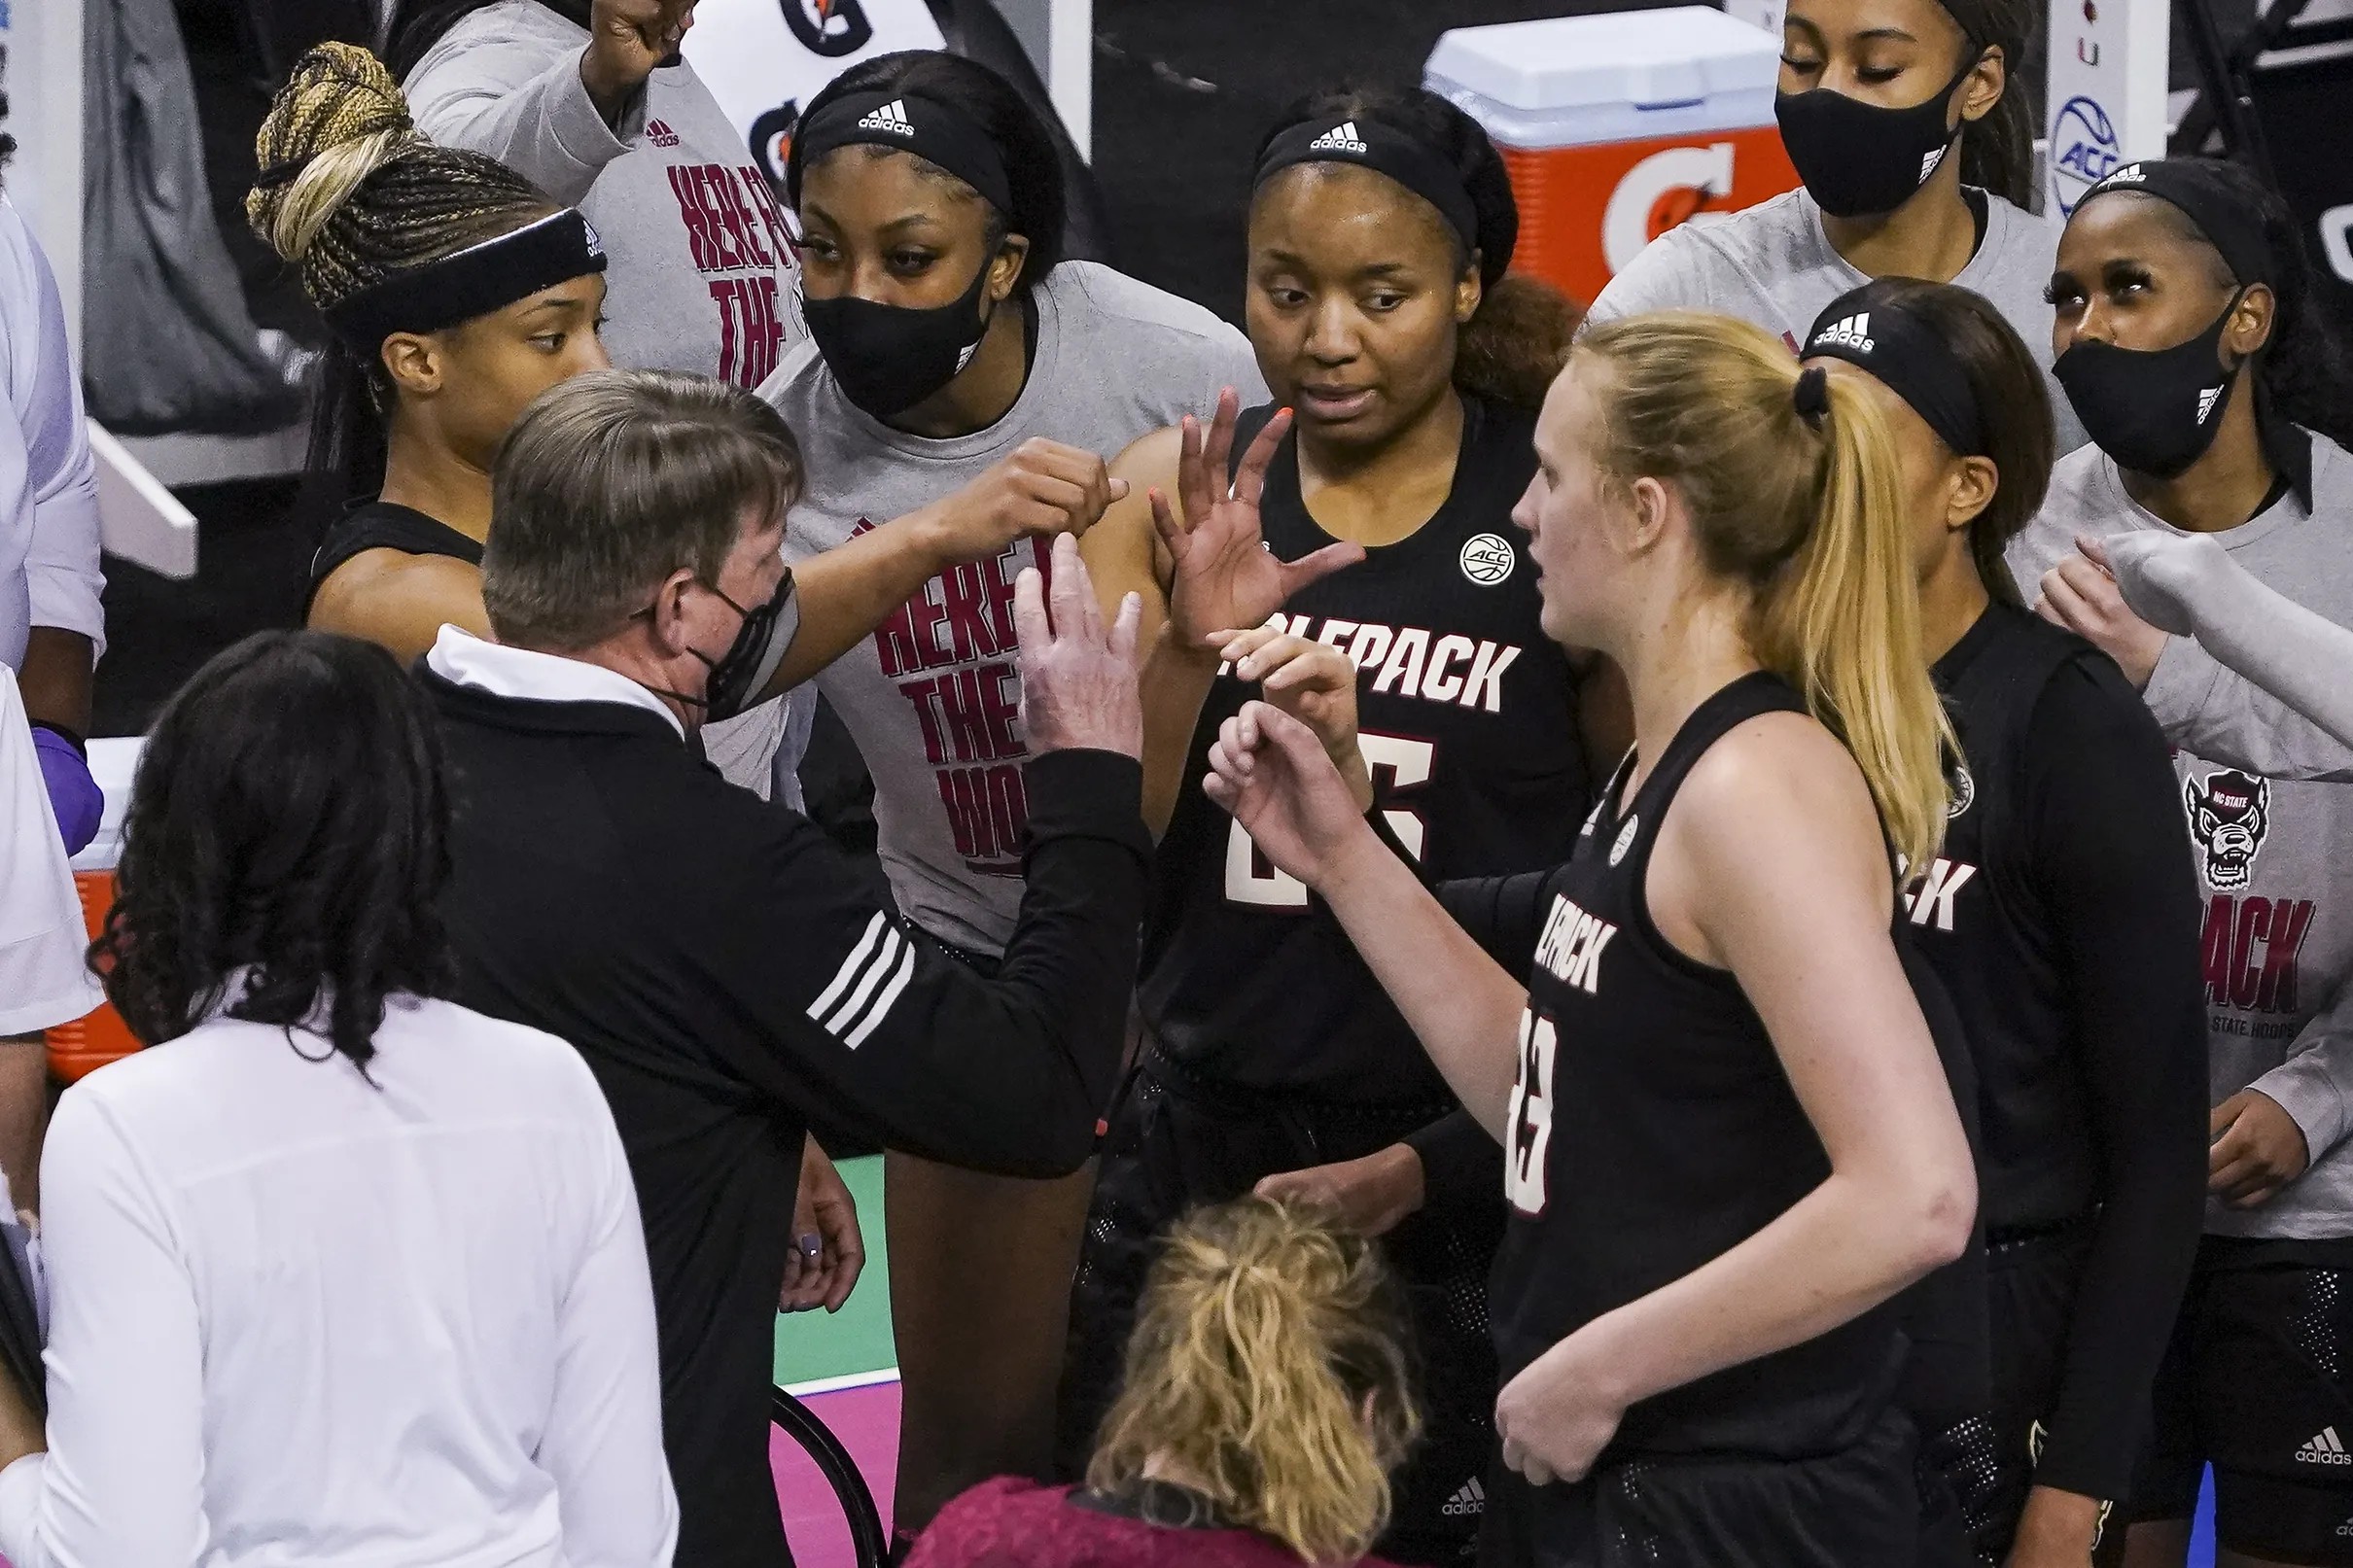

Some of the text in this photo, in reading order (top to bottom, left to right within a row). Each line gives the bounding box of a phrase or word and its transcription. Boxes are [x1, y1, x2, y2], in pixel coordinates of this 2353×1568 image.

[858, 117, 915, 136] adidas
[1310, 137, 1367, 153] adidas
[1813, 330, 1875, 354] adidas
[1469, 549, 1511, 564] ACC
[898, 664, 1030, 765] THE
[2213, 790, 2249, 808] NC STATE
[2295, 1448, 2353, 1465] adidas
